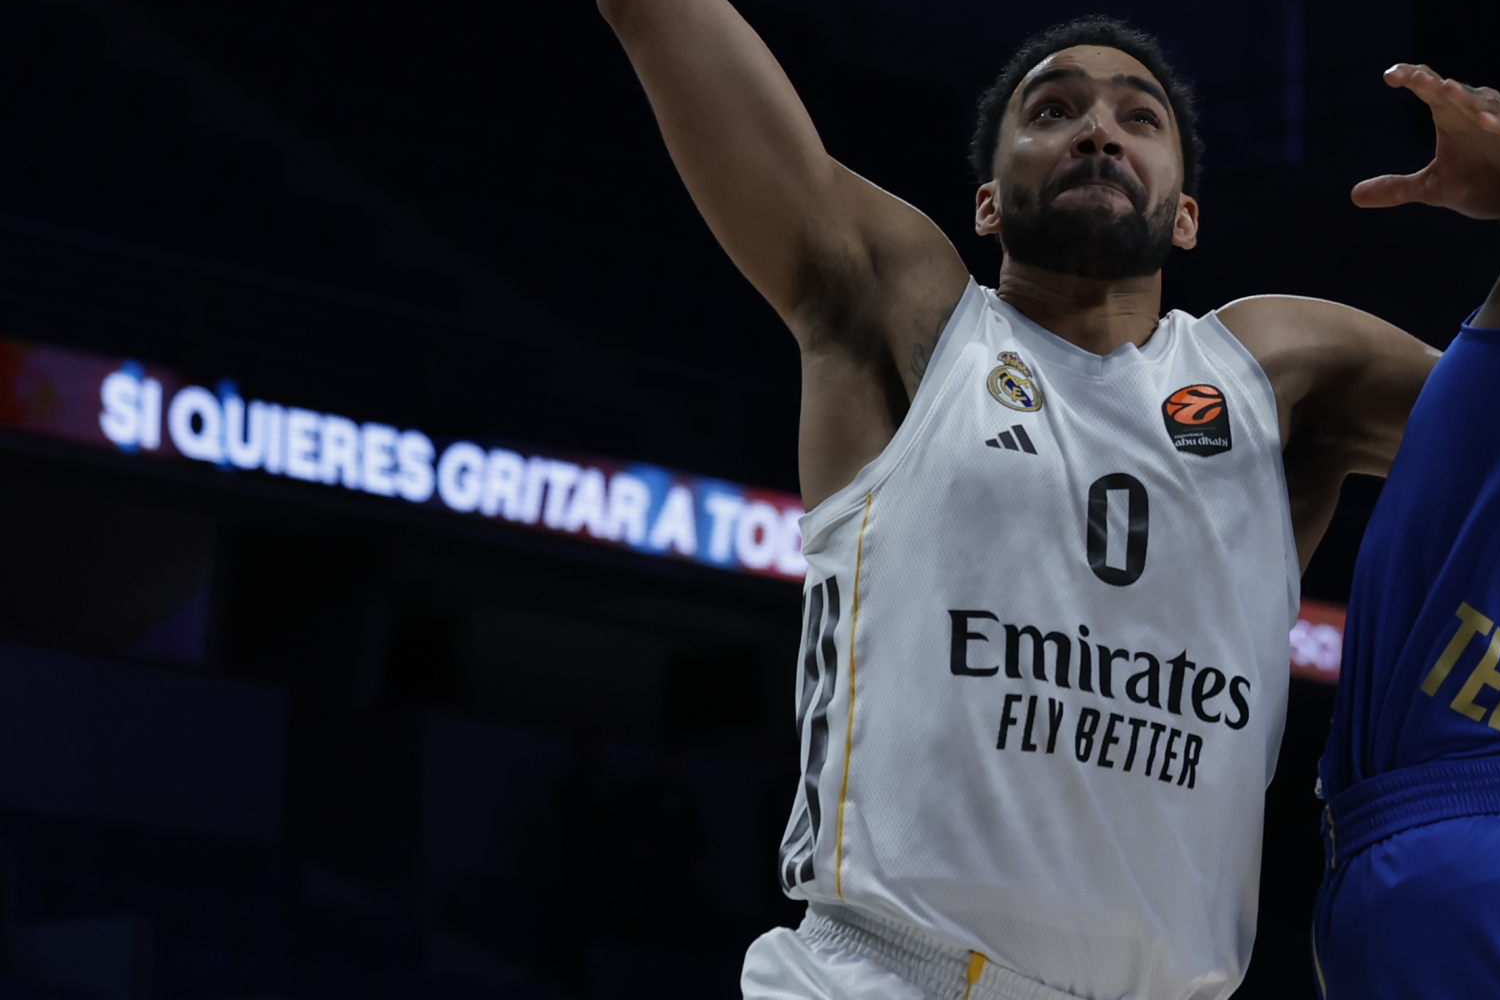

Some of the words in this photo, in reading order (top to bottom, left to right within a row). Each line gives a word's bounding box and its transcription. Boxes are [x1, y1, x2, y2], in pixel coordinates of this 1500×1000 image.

[100, 371, 163, 452] SI
[168, 385, 436, 502] QUIERES
[437, 440, 651, 548] GRITAR
[649, 484, 698, 556] A
[1174, 437, 1197, 447] abu
[1197, 435, 1229, 447] dhabi
[1086, 472, 1149, 587] 0
[948, 610, 1251, 730] Emirates
[996, 693, 1064, 755] FLY
[1075, 706, 1203, 790] BETTER
